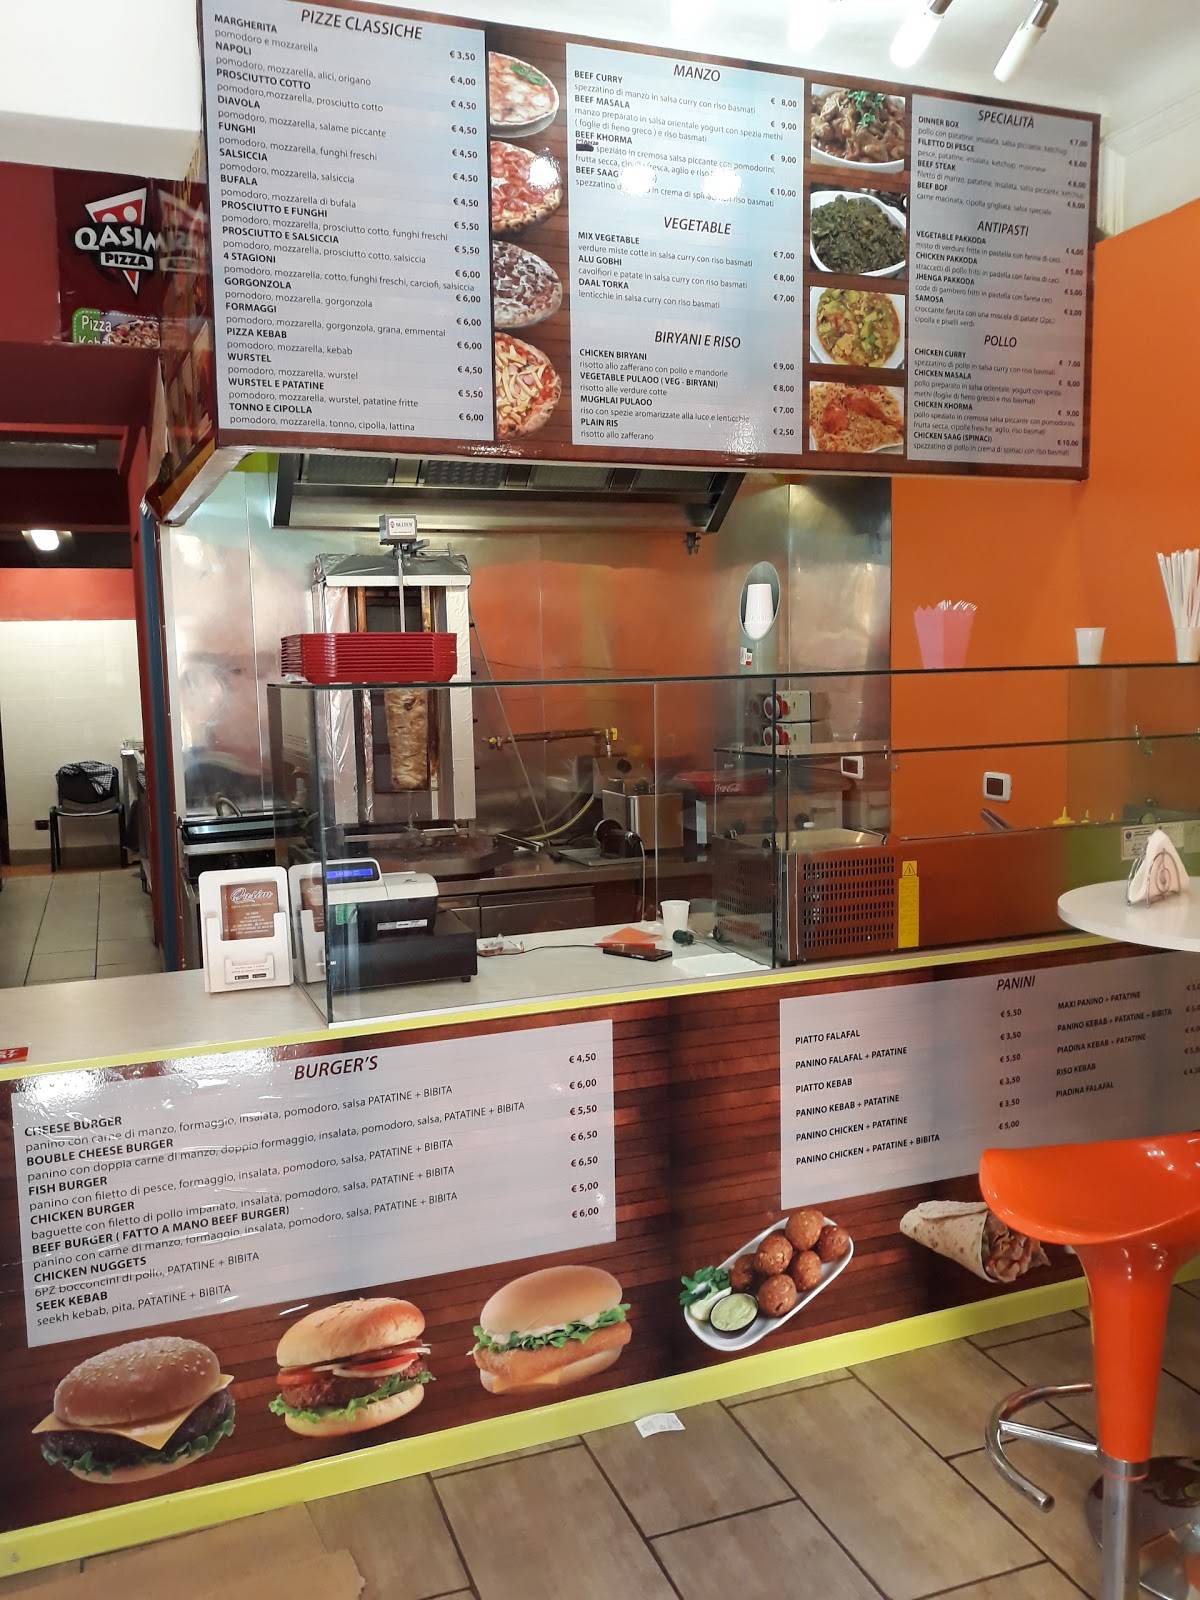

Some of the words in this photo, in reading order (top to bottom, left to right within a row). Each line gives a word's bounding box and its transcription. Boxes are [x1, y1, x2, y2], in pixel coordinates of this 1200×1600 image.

[214, 13, 277, 33] MARGHERITA
[301, 8, 342, 28] PIZZE
[345, 16, 423, 40] CLASSICHE
[214, 29, 262, 45] pomodoro
[264, 38, 269, 46] e
[271, 39, 318, 53] mozzarella
[215, 41, 251, 56] NAPOLI
[216, 68, 277, 85] PROSCIUTTO
[279, 78, 311, 90] COTTO
[574, 70, 593, 80] BEEF
[595, 73, 622, 84] CURRY
[673, 64, 720, 82] MANZO
[217, 95, 260, 109] DIAVOLA
[574, 94, 593, 103] BEEF
[596, 97, 630, 109] MASALA
[218, 121, 255, 134] FUNGHI
[575, 130, 594, 141] BEEF
[596, 132, 632, 144] KHORMA
[219, 148, 267, 161] SALSICCIA
[575, 165, 594, 175] BEEF
[596, 168, 618, 177] SAAG
[220, 174, 258, 186] BUFALA
[221, 200, 281, 214] PROSCIUTTO
[291, 206, 327, 217] FUNGHI
[664, 216, 731, 235] VEGETABLE
[222, 226, 282, 239] PROSCIUTTO
[292, 232, 339, 243] SALSICCIA
[578, 231, 593, 240] MIX
[594, 232, 639, 244] VEGETABLE
[104, 253, 148, 267] PIZZA
[223, 252, 229, 260] 4
[231, 253, 275, 263] STAGIONI
[578, 254, 594, 263] ALU
[595, 256, 622, 266] GOBHI
[224, 276, 291, 289] GORGONZOLA
[578, 277, 601, 287] DAAL
[601, 279, 629, 289] TORKA
[225, 302, 276, 313] FORMAGGI
[82, 316, 111, 332] Pizza
[226, 327, 254, 336] PIZZA
[256, 328, 287, 338] KEBAB
[654, 330, 702, 346] BIRYANI
[713, 335, 740, 348] RISO
[226, 340, 275, 352] pomodoro,
[277, 343, 324, 355] mozzarella,
[326, 345, 352, 356] kebab
[579, 348, 614, 358] CHICKEN
[616, 350, 646, 360] BIRYANI
[227, 352, 272, 362] WURSTEL
[228, 377, 272, 387] WURSTEL
[282, 380, 324, 390] PATATINE
[580, 384, 604, 392] risotto
[620, 387, 647, 395] verdure
[648, 388, 667, 396] cotte
[228, 402, 264, 411] TONNO
[273, 404, 312, 413] CIPOLLA
[580, 395, 618, 404] MUGHLAI
[619, 396, 652, 406] PULAOO
[580, 418, 604, 426] PLAIN
[606, 419, 618, 427] RIS
[996, 975, 1035, 991] PANINI
[795, 1033, 824, 1044] PIATTO
[825, 1029, 860, 1040] FALAFAL
[576, 1052, 596, 1063] 4,50
[795, 1057, 827, 1069] PANINO
[828, 1052, 863, 1064] FALAFAL
[871, 1046, 906, 1059] PATATINE
[294, 1055, 378, 1080] BURGER'S
[795, 1081, 824, 1093] PIATTO
[826, 1077, 852, 1089] KEBAB
[795, 1105, 827, 1117] PANINO
[828, 1101, 855, 1112] KEBAB
[863, 1094, 899, 1106] PATATINE
[24, 1122, 70, 1136] CHEESE
[73, 1116, 122, 1130] BURGER
[26, 1151, 75, 1166] BOUBLE
[78, 1145, 123, 1159] CHEESE
[126, 1138, 173, 1153] BURGER
[796, 1152, 828, 1165] PANINO
[828, 1146, 863, 1159] CHICKEN
[872, 1139, 907, 1152] PATATINE
[915, 1134, 939, 1144] BIBITA
[28, 1183, 55, 1196] FISH
[58, 1176, 107, 1192] BURGER
[30, 1208, 83, 1225] CHICKEN
[86, 1201, 134, 1216] BURGER
[32, 1241, 61, 1255] BEEF
[64, 1233, 113, 1249] BURGER
[122, 1226, 158, 1240] FATTO
[172, 1218, 208, 1232] MANO
[211, 1213, 238, 1226] BEEF
[241, 1205, 289, 1221] BURGER)
[34, 1266, 87, 1282] CHICKEN
[90, 1256, 146, 1274] NUGGETS
[36, 1298, 65, 1311] SEEK
[68, 1290, 108, 1306] KEBAB
[37, 1312, 69, 1326] seekh
[72, 1305, 109, 1319] kebab,
[112, 1301, 135, 1314] pita,
[138, 1291, 187, 1308] PATATINE
[199, 1284, 231, 1298] BIBITA
